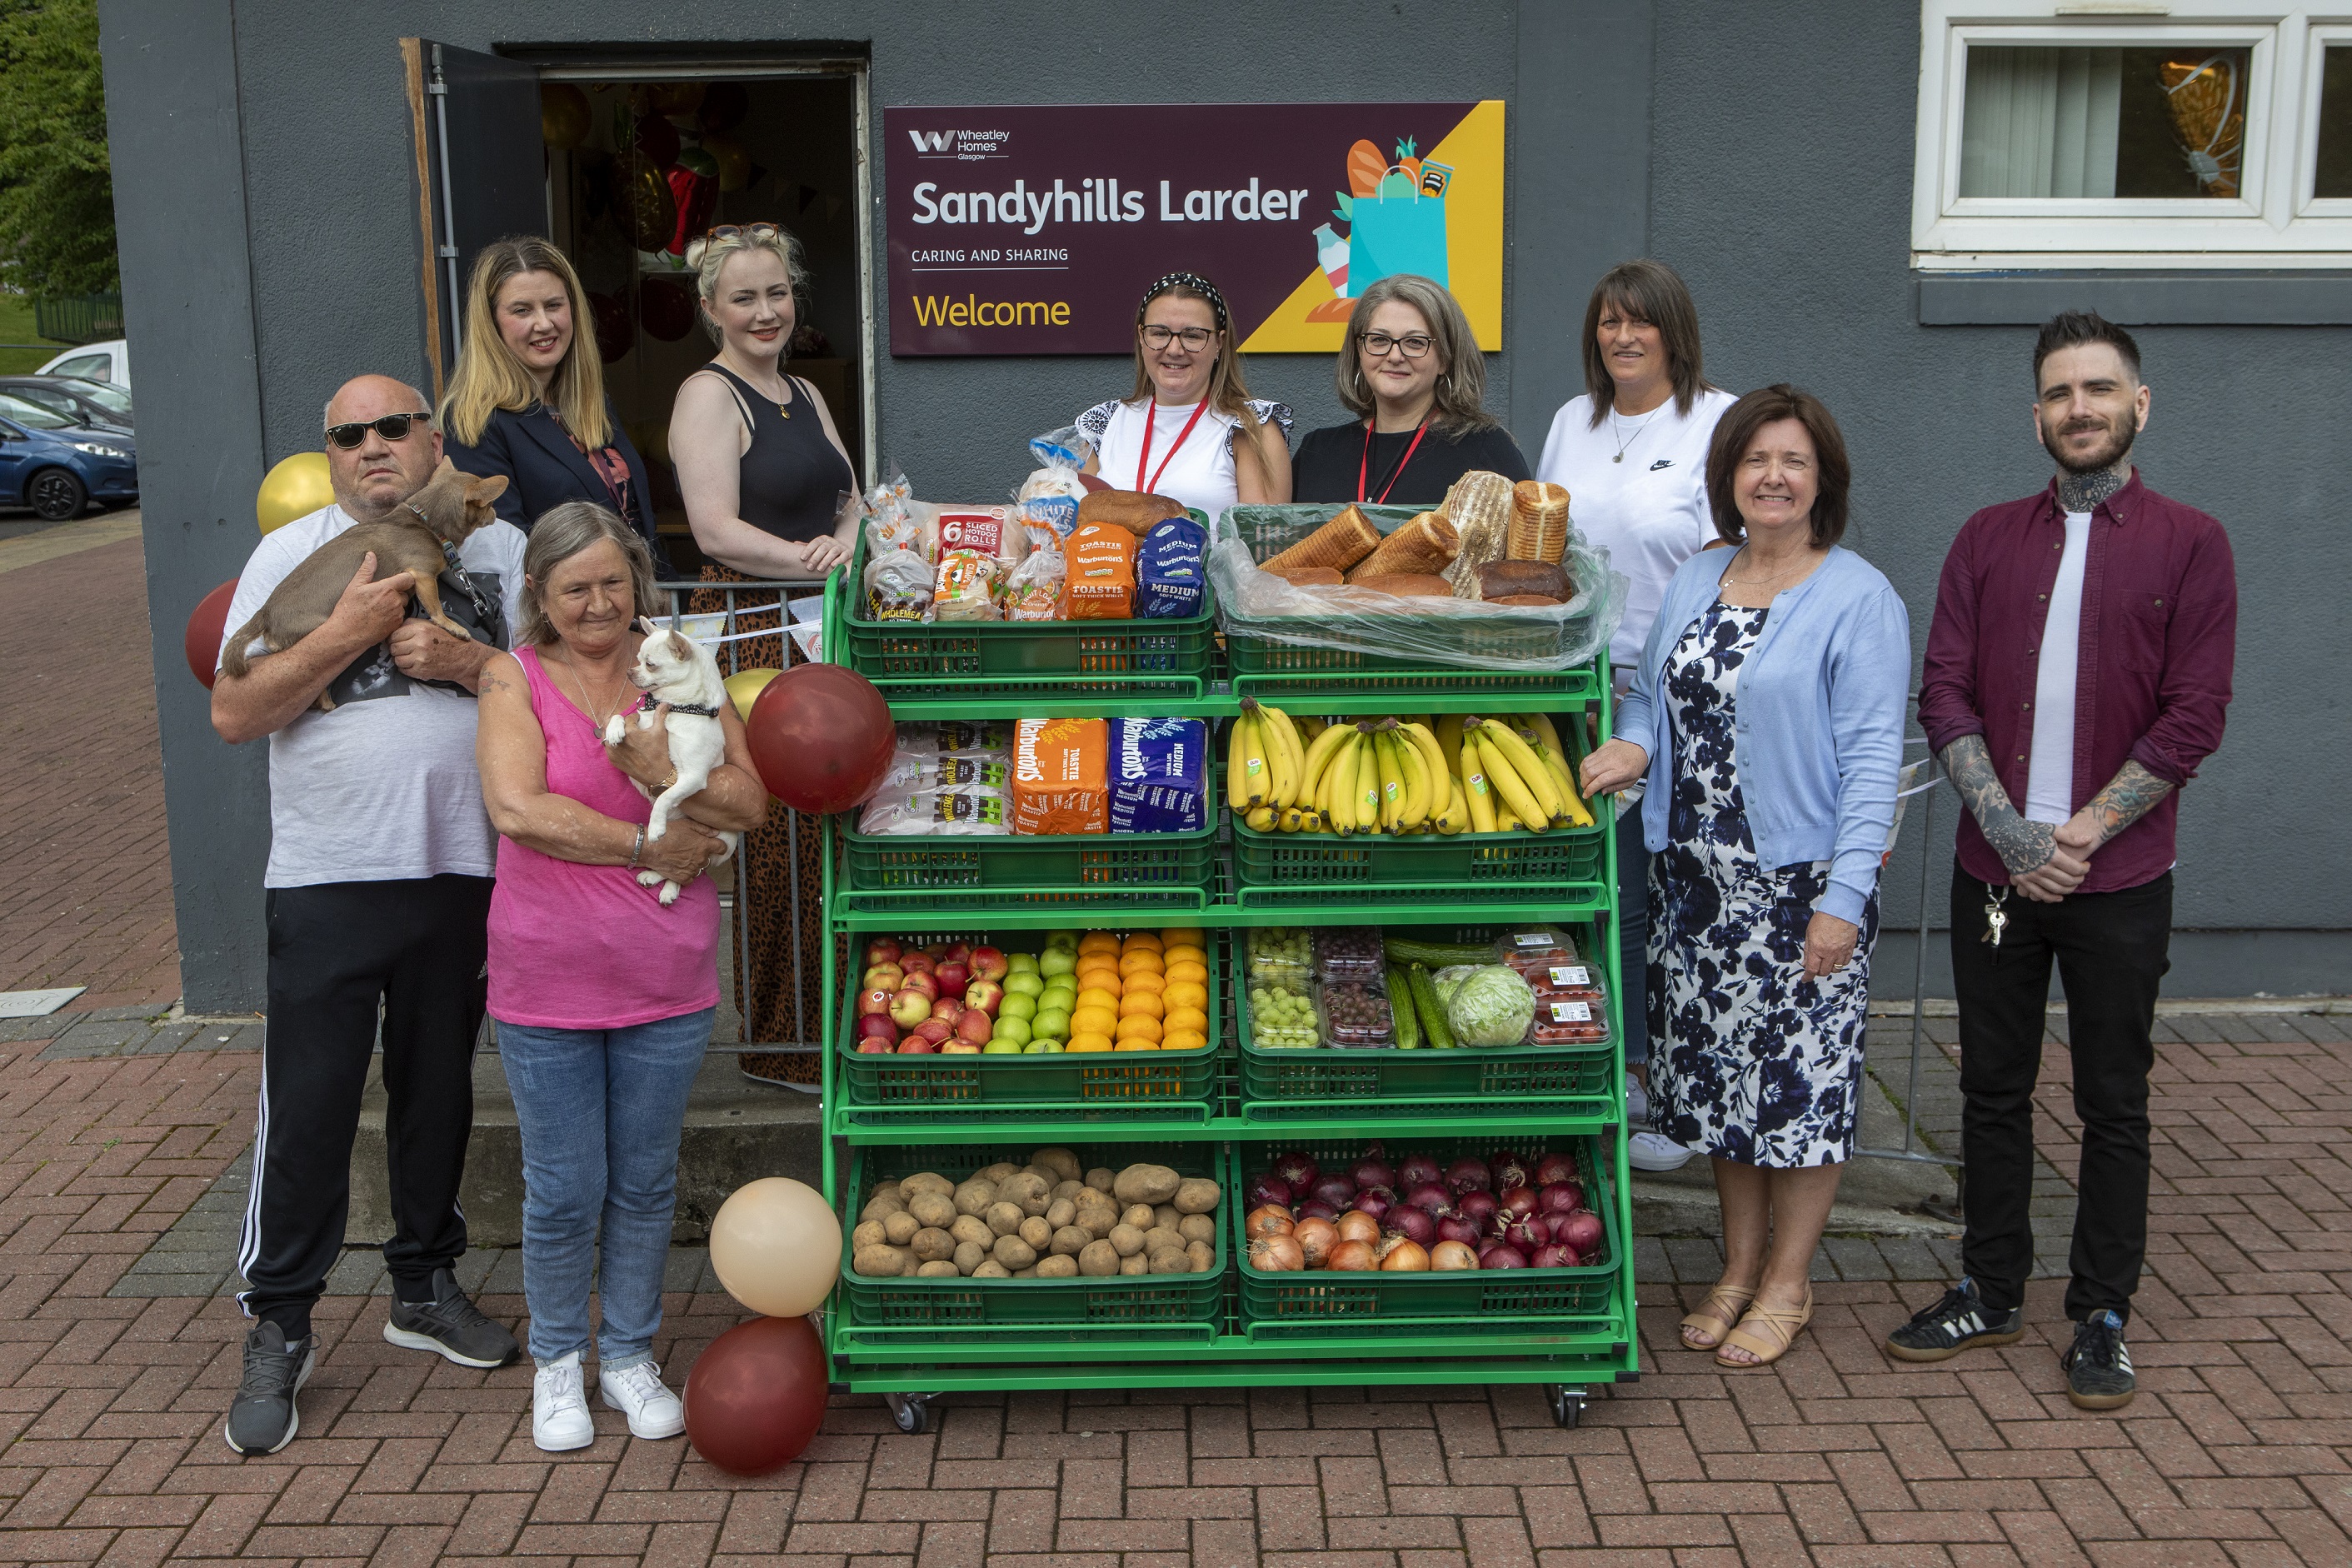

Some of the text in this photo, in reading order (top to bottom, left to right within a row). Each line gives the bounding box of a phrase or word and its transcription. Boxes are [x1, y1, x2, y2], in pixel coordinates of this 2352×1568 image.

[957, 129, 1010, 142] Wheatley
[957, 142, 996, 152] Homes
[912, 177, 1308, 235] Sandyhills Larder
[911, 248, 1069, 262] CARING AND SHARING
[912, 293, 1071, 327] Welcome
[943, 522, 962, 542] 6
[965, 528, 997, 538] HOTDOG
[966, 522, 998, 532] SLICED
[964, 535, 996, 545] ROLLS
[1080, 541, 1122, 549] TOASTIE
[1158, 540, 1197, 553] MEDIUM
[1076, 556, 1123, 564] Warburtons
[1156, 555, 1200, 567] Warburtons
[1072, 586, 1124, 594] TOASTIE
[1151, 583, 1200, 597] MEDIUM
[1021, 589, 1037, 606] FRUIT
[1016, 718, 1050, 782] Warburtons
[1121, 717, 1148, 780] Warburtons
[1069, 748, 1081, 781] TOASTIE
[1173, 743, 1184, 777] MEDIUM
[1116, 793, 1138, 801] MEDIUM
[1021, 807, 1041, 816] TOASTIE
[1017, 819, 1038, 828] TOASTIE
